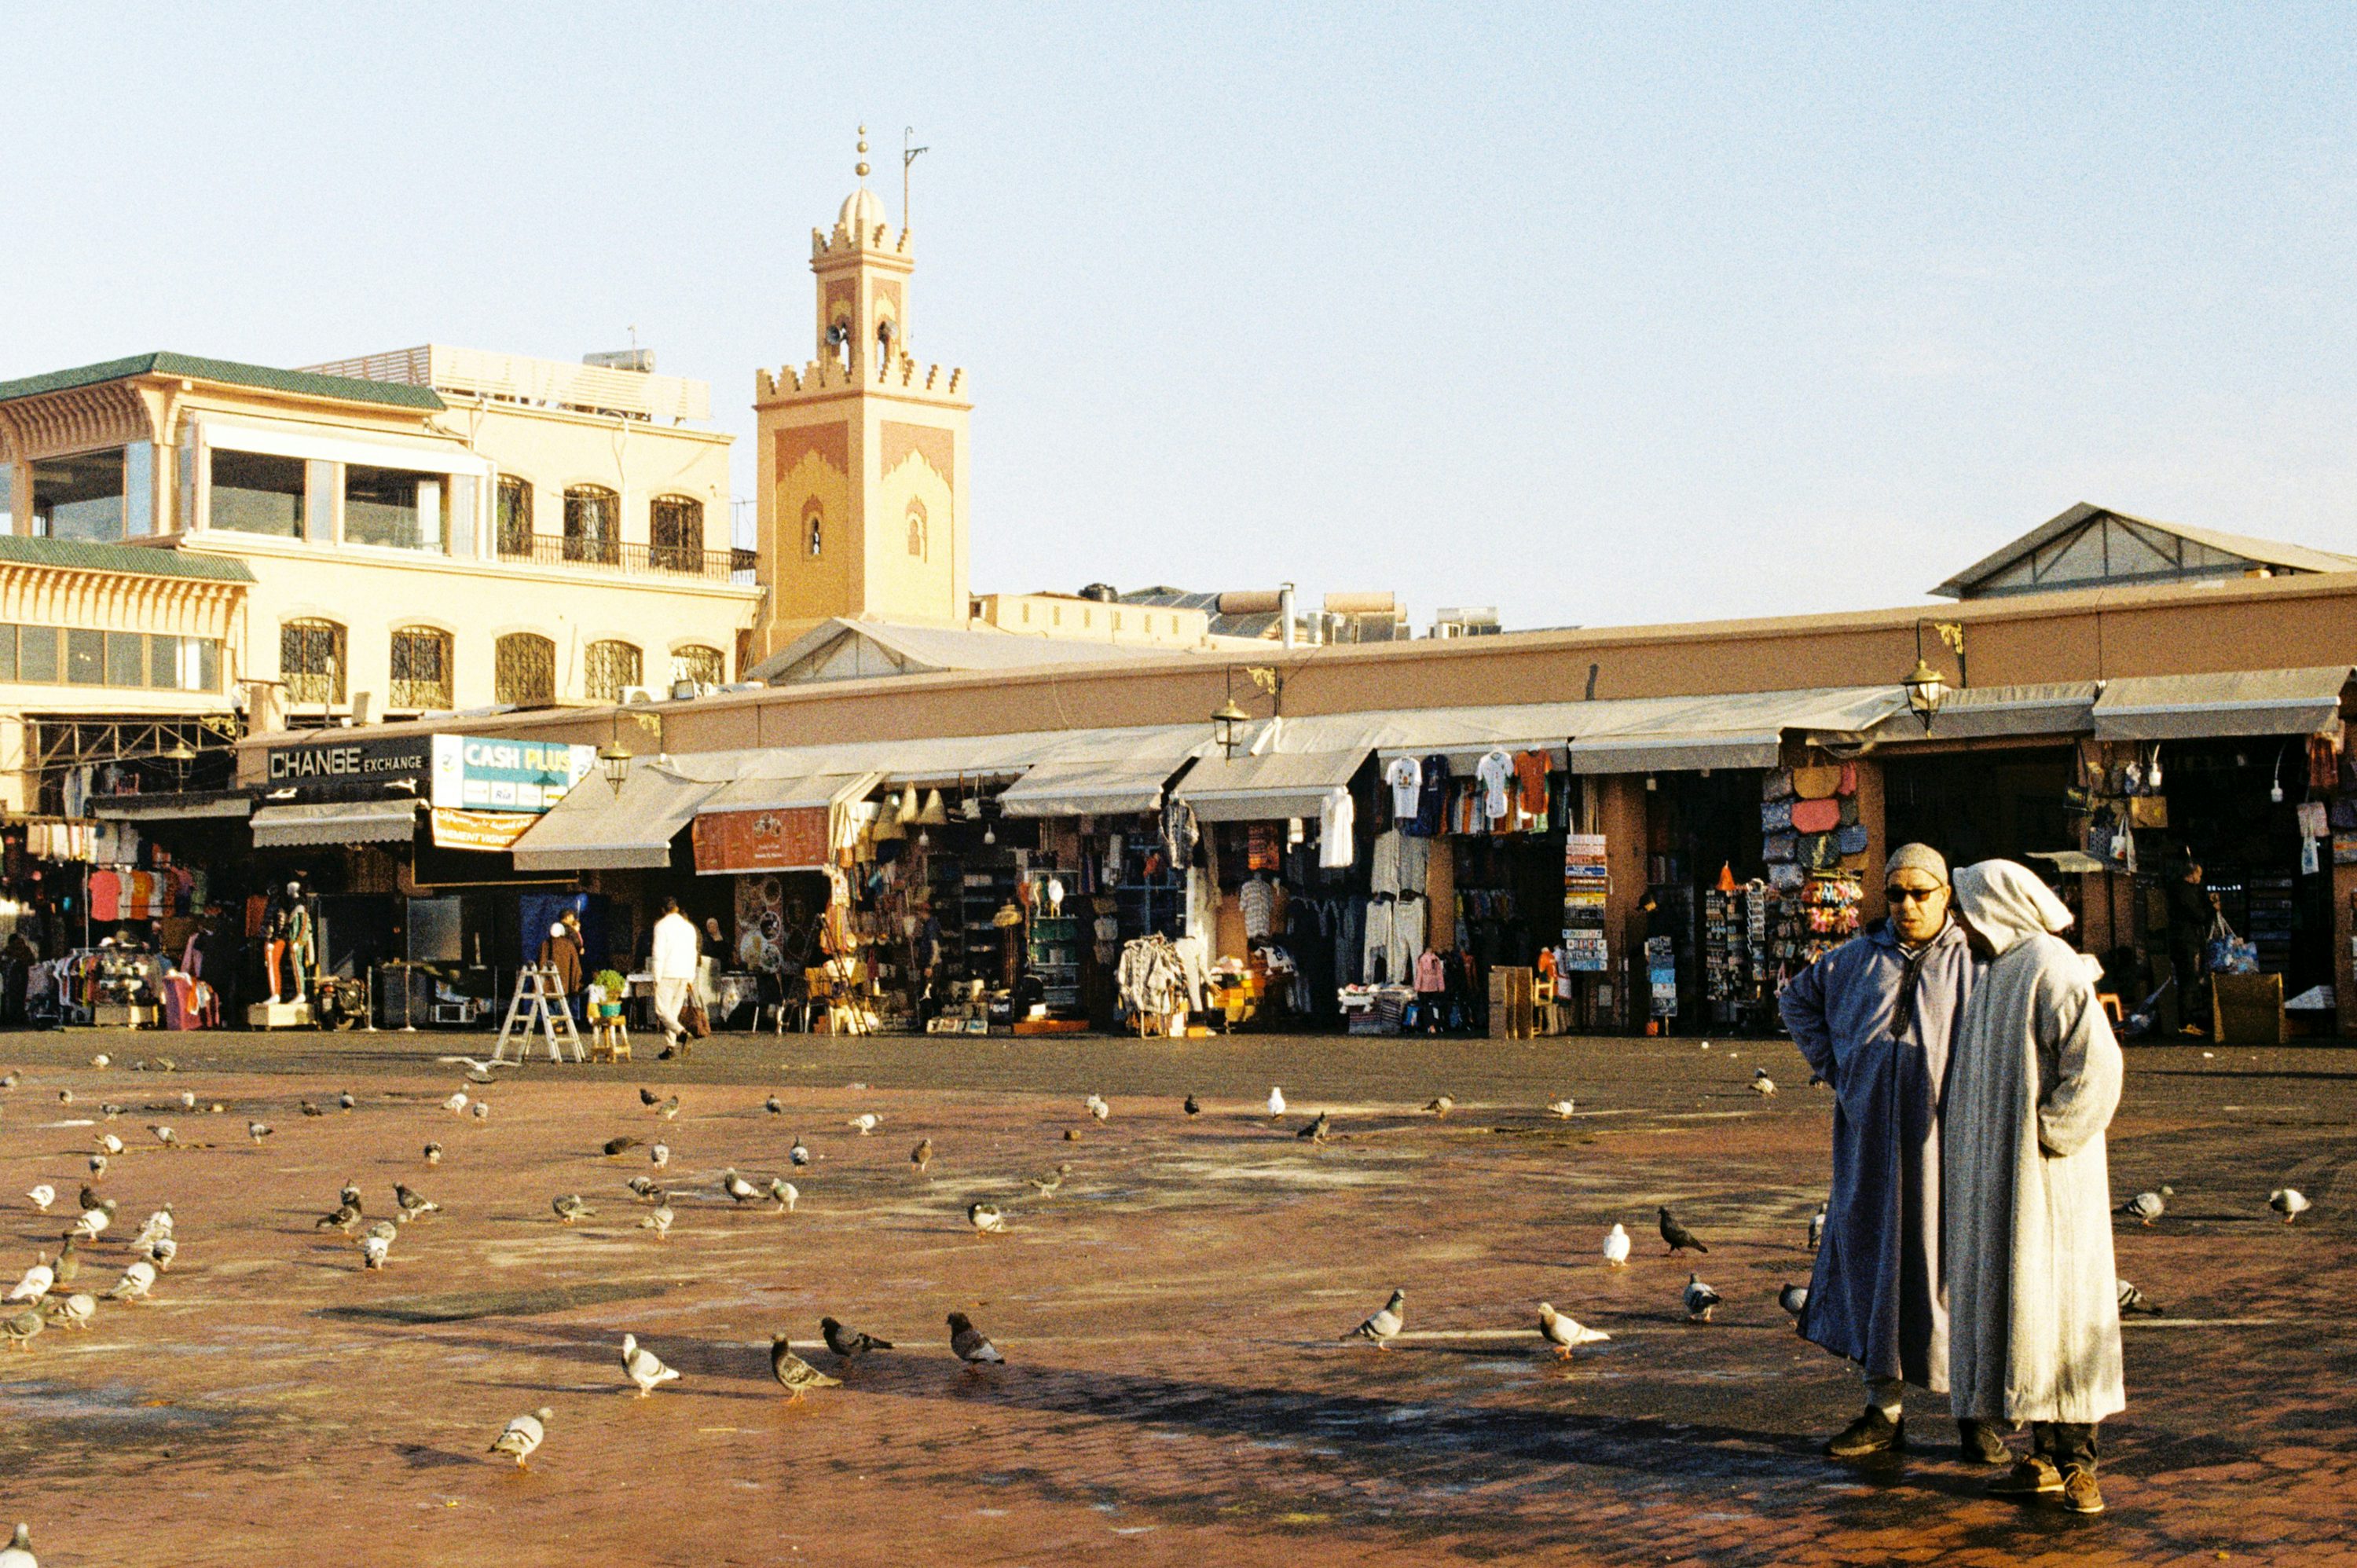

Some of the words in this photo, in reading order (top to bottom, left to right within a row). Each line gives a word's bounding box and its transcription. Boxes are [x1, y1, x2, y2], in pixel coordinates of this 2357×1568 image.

[269, 747, 361, 779] CHANGE
[364, 755, 422, 773] EXCHANGE
[464, 743, 519, 770] CASH
[525, 748, 573, 773] PLUS
[495, 789, 511, 800] Ria
[482, 833, 516, 844] VIGNETT
